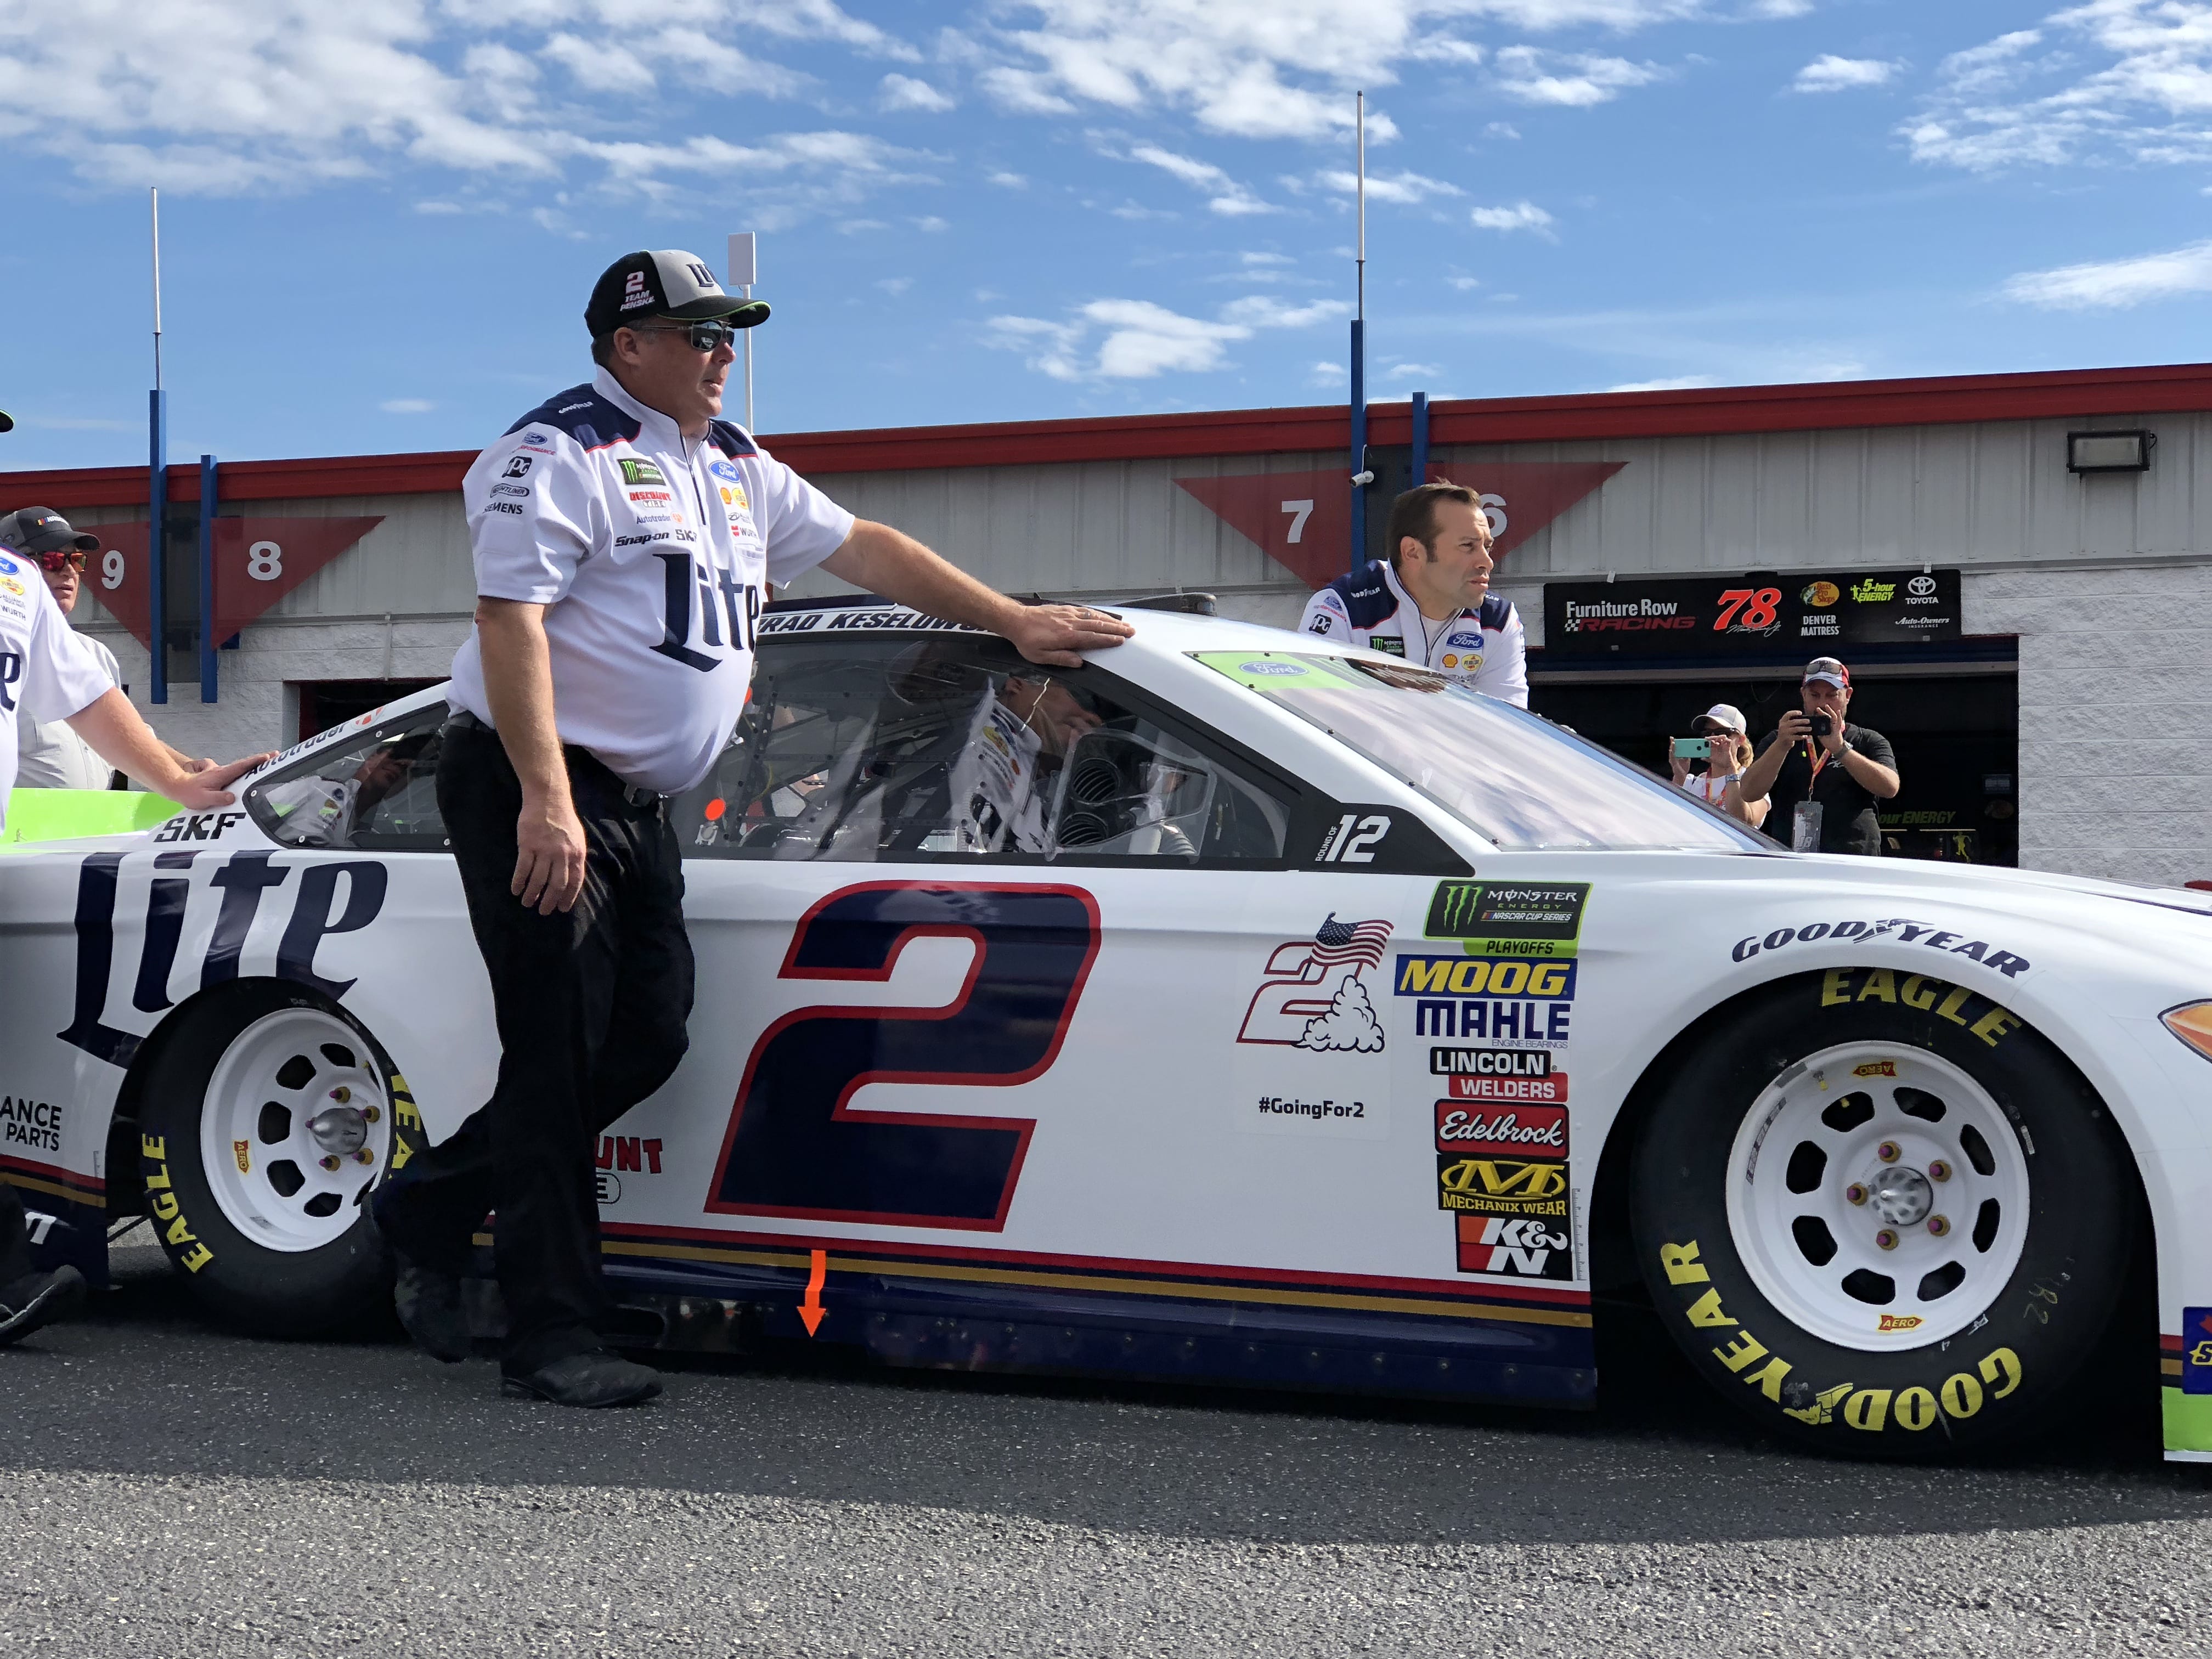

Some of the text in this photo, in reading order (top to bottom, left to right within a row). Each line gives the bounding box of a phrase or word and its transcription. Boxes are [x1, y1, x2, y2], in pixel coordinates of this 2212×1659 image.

[625, 271, 644, 295] 2
[625, 290, 650, 302] TEAM
[719, 462, 738, 479] Ford
[629, 491, 672, 501] DISCOUNT
[483, 502, 523, 515] SIEMENS
[1483, 493, 1508, 538] 6
[636, 514, 671, 524] Autotrader
[1281, 499, 1313, 544] 7
[614, 532, 670, 547] Snap-on
[101, 550, 125, 589] 9
[247, 540, 281, 580] 8
[1864, 578, 1897, 592] 5-hour
[1816, 595, 1835, 604] Shops
[1858, 591, 1894, 602] ENERGY
[1905, 596, 1939, 605] TOYOTA
[649, 553, 760, 673] Lite
[1566, 599, 1678, 618] Furniture Row
[1713, 588, 1782, 630] 78
[826, 612, 989, 631] KESELOW
[1311, 616, 1331, 631] PPG
[1578, 616, 1696, 631] RACING
[1803, 615, 1836, 625] DENVER
[1895, 617, 1950, 625] Auto-Owners
[1453, 633, 1480, 646] Ford
[1801, 625, 1839, 636] MATTRESS
[1253, 663, 1298, 674] Ford
[1902, 811, 1956, 823] ENERGY
[153, 812, 246, 843] SKF
[1315, 826, 1338, 861] ROUND OF
[1324, 814, 1392, 862] 12
[1487, 889, 1577, 901] MONSTER
[1486, 940, 1555, 955] PLAYOFFS
[57, 850, 388, 1070] Lite
[1400, 960, 1571, 996] MOOG
[1821, 967, 2022, 1047] EAGLE
[1416, 1000, 1571, 1040] MAHLE
[1492, 1039, 1568, 1049] ENGINE BEARINGS
[703, 879, 1102, 1233] 2
[1436, 1051, 1544, 1075] LINCOLN
[1859, 1064, 1892, 1074] AERO
[1460, 1079, 1555, 1098] WELDERS
[0, 1096, 62, 1131] ANCE
[1259, 1098, 1364, 1119] #GoingFor2
[5, 1122, 60, 1152] PARTS
[1440, 1110, 1564, 1147] Edelbrock
[235, 1146, 248, 1170] AERO
[142, 1132, 215, 1273] EAGLE
[1442, 1192, 1566, 1216] MECHANIX WEAR
[1882, 1317, 1917, 1328] AERO
